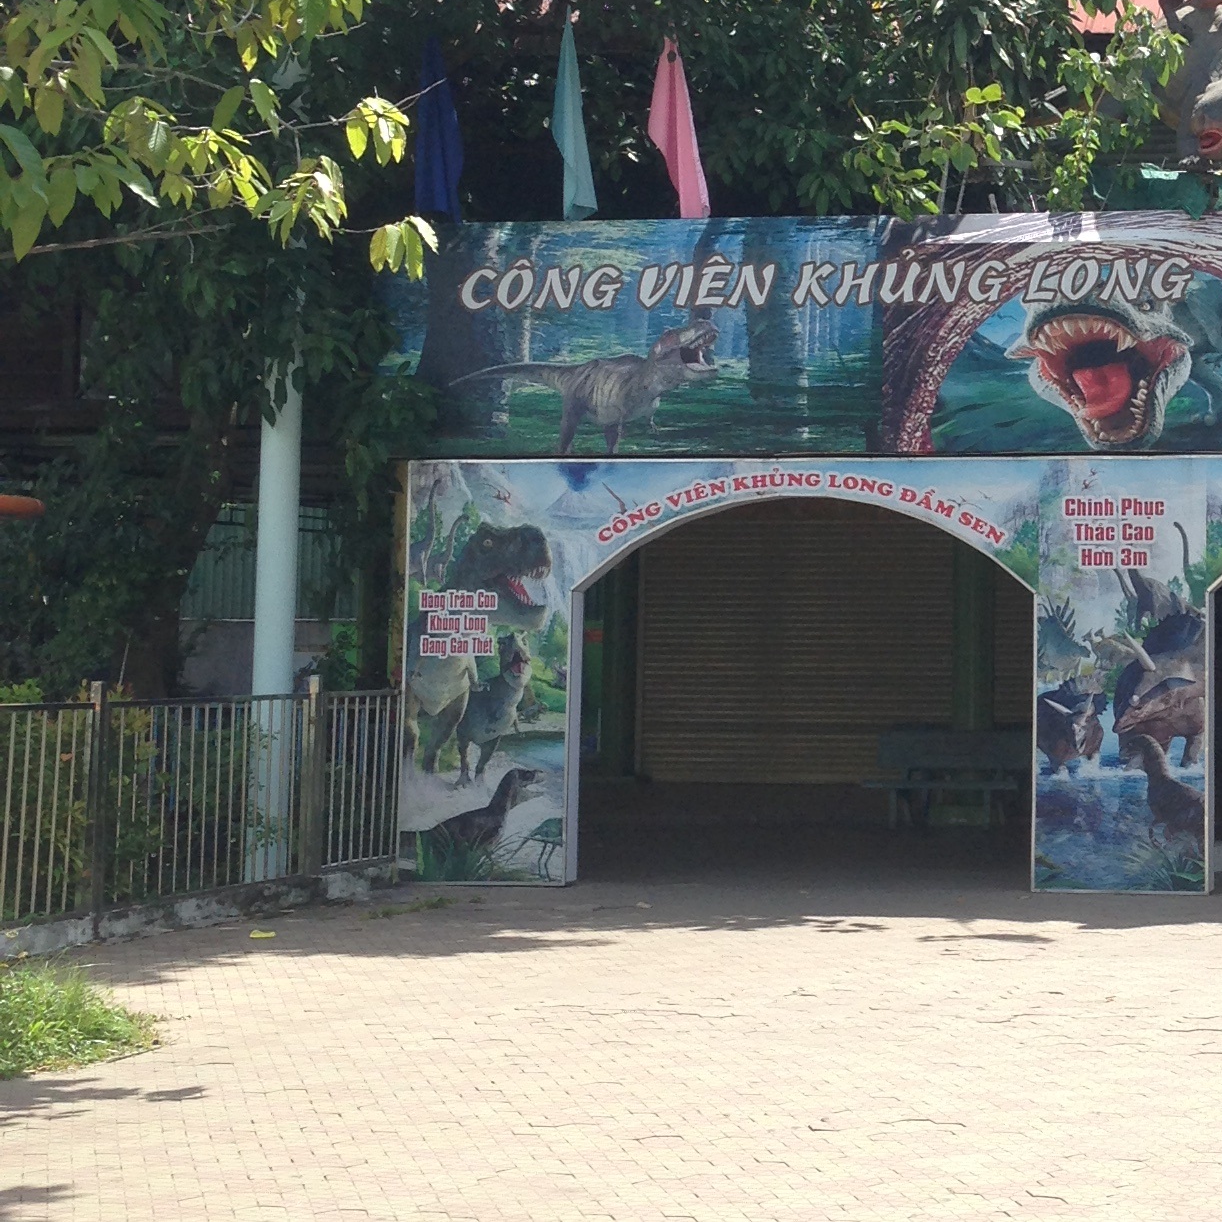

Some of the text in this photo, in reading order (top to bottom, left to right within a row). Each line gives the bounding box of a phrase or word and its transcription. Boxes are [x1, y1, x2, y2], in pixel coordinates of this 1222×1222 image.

[460, 255, 623, 310] CÔNG
[638, 253, 777, 310] VIÊN
[792, 248, 1006, 308] KHỦNG
[1022, 255, 1194, 303] LONG
[598, 468, 1005, 545] CÔNG VIÊN KHỦNG LONG ĐẦM SEN
[1065, 498, 1164, 519] Chinh Phục
[1122, 523, 1154, 541] Cao
[1081, 548, 1147, 566] Hơn 3m
[478, 592, 496, 608] Con
[464, 615, 486, 633] Long
